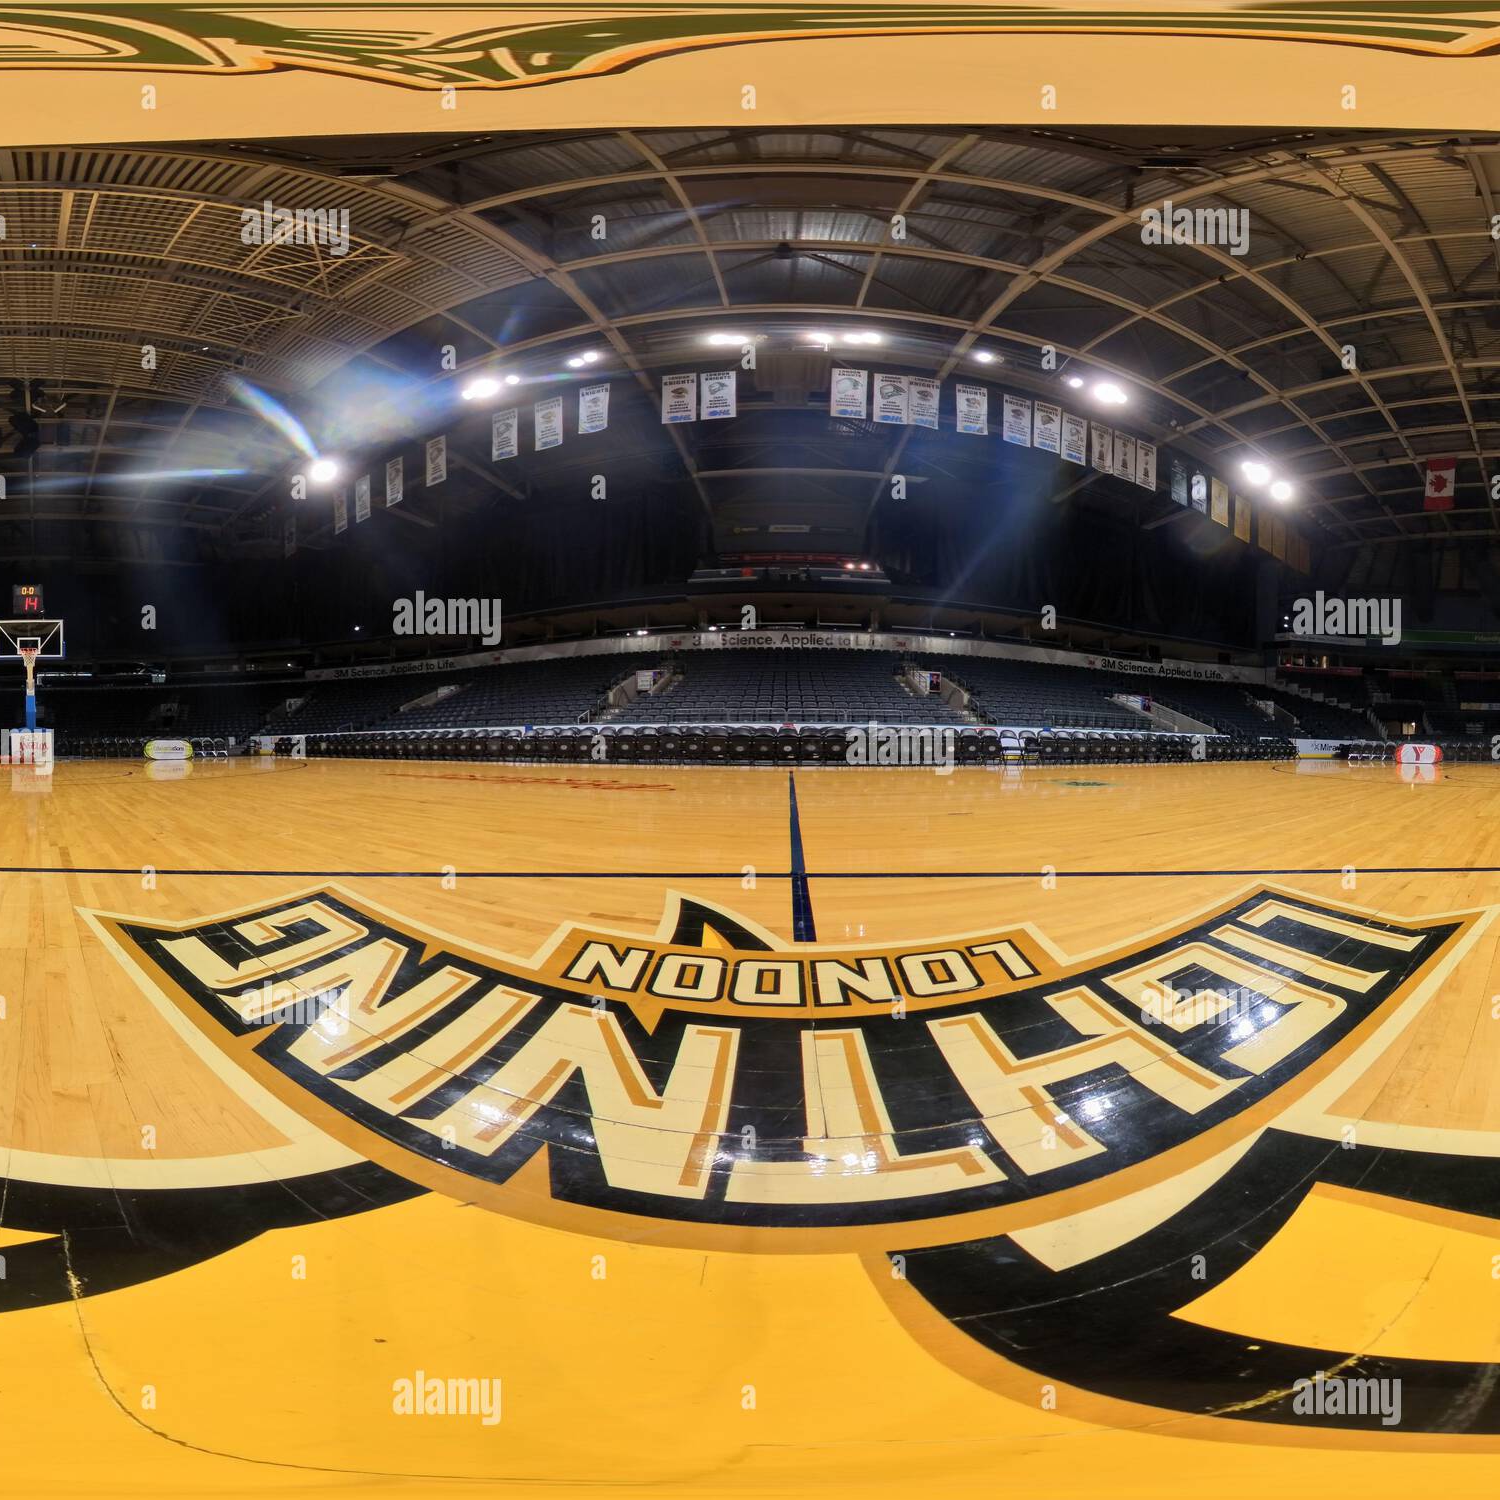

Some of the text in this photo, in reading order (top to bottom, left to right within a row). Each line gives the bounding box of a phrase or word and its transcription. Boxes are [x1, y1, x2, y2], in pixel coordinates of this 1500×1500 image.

[25, 597, 38, 611] 14
[721, 633, 851, 648] Science. Applied to
[333, 660, 456, 679] 3M Science. Applied to Life.
[1101, 658, 1224, 680] 3M Science. Applied to Life.
[565, 940, 1038, 1004] LONDON
[155, 899, 1426, 1203] LIGHTNING
